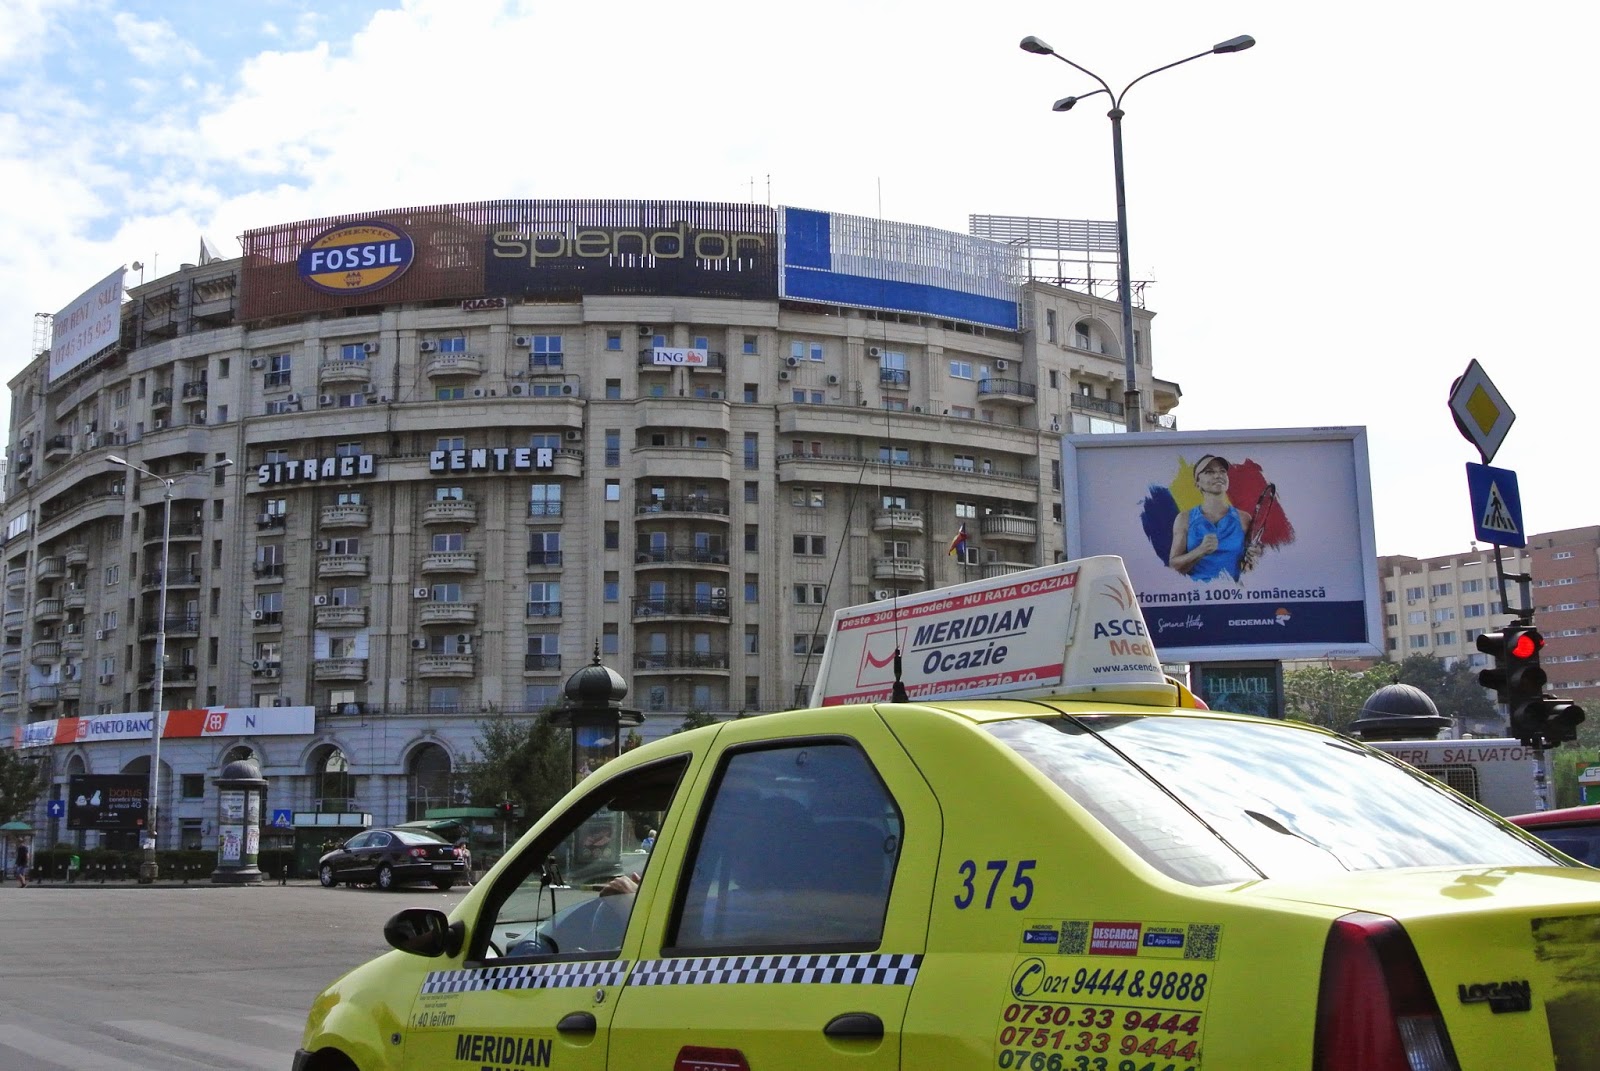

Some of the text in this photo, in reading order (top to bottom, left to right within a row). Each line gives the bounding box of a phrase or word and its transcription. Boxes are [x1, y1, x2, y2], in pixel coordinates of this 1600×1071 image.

[320, 226, 392, 247] AUTHENTIC
[493, 220, 766, 268] splend'or
[310, 243, 402, 271] FOSSIL
[54, 317, 68, 341] FOR
[70, 302, 90, 330] RENT
[97, 282, 119, 310] SALE
[656, 351, 684, 363] ING
[258, 447, 553, 484] SITRACO CENTER
[841, 616, 871, 630] peste
[873, 611, 894, 622] 300
[895, 609, 909, 618] de
[912, 600, 953, 615] modele
[963, 594, 982, 605] NU
[985, 587, 1017, 601] RATA
[1020, 575, 1074, 595] OCAZIA!
[1205, 588, 1243, 601] 100%
[1247, 586, 1326, 600] românească
[912, 606, 1034, 647] MERIDIAN
[1228, 618, 1274, 627] DEDEMAN
[923, 641, 1008, 675] Ocazie
[90, 718, 154, 735] VENETO BANC
[245, 714, 256, 728] N
[109, 787, 142, 797] bonus
[131, 801, 142, 809] 4G
[954, 859, 1037, 911] 375
[1093, 927, 1139, 940] DESCARCA
[1043, 976, 1070, 994] 021
[1458, 979, 1531, 1004] LOGAN
[1003, 1003, 1201, 1036] 0730.33 9444
[455, 1034, 553, 1068] MERIDIAN
[1000, 1026, 1198, 1061] 0751.33 9444
